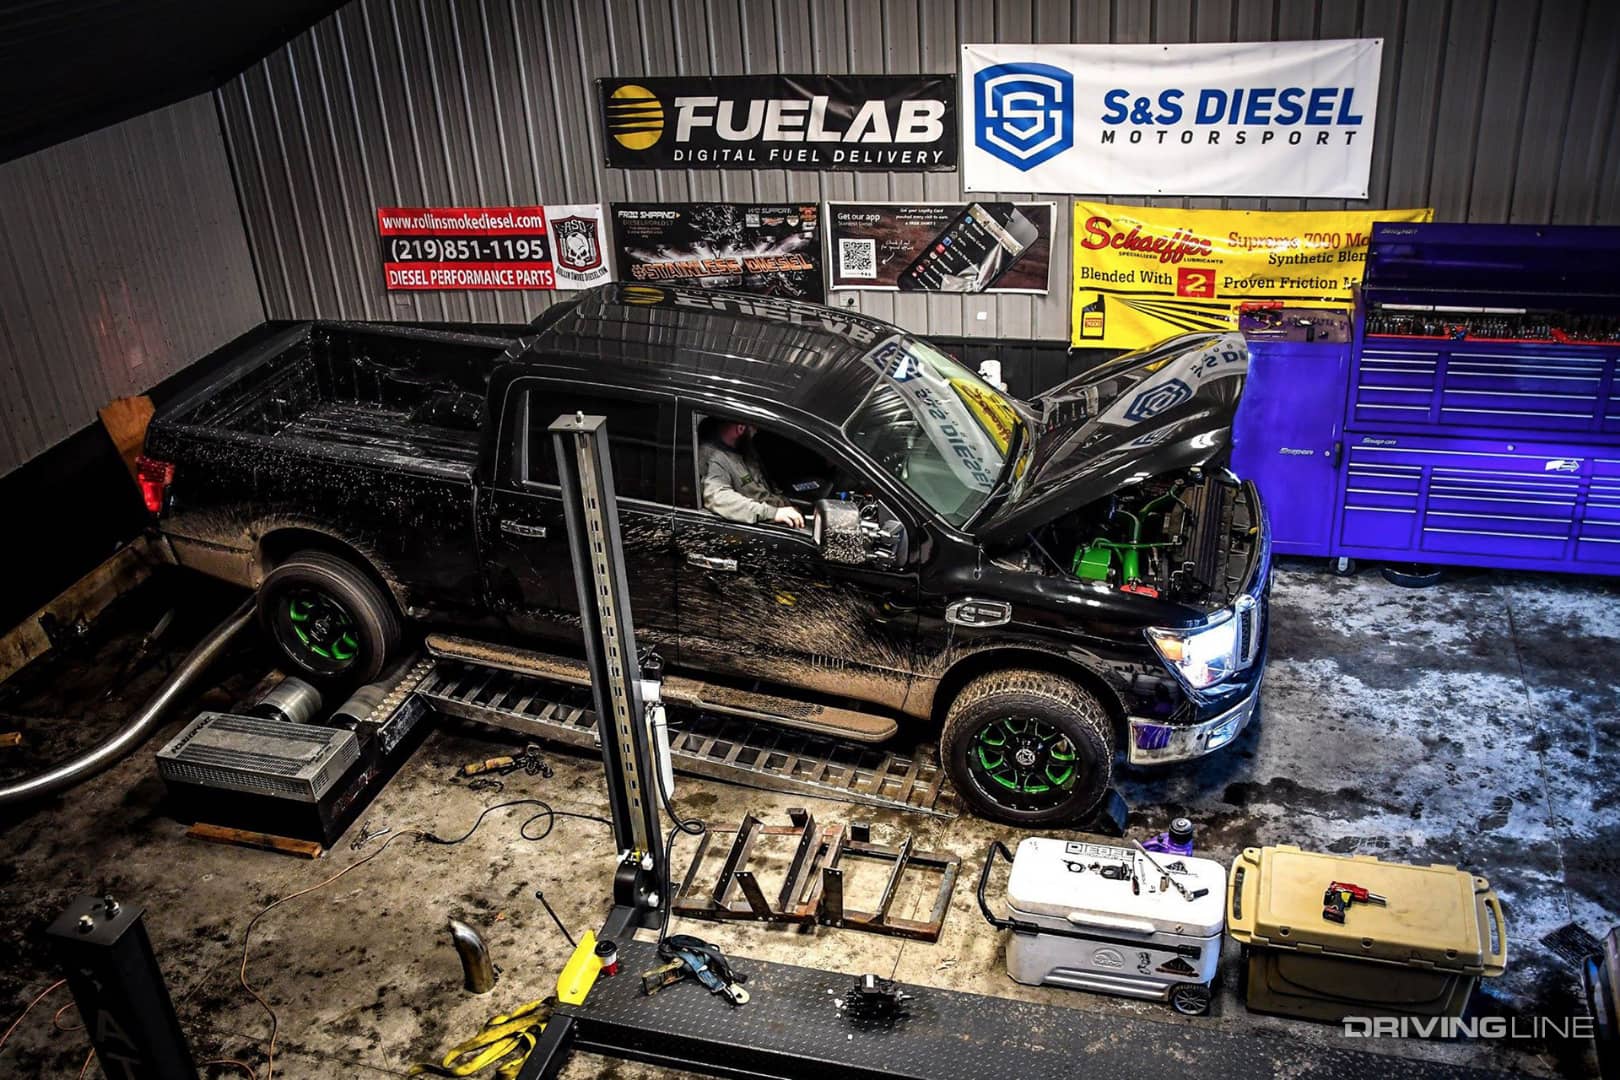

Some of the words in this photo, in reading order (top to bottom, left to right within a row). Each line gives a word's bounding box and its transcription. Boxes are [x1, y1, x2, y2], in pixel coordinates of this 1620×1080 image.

[1101, 88, 1185, 126] S&S
[1194, 86, 1364, 126] DIESEL
[674, 96, 946, 143] FUELAB
[1101, 130, 1359, 146] MOTORSPORT
[674, 149, 756, 161] DIGITAL
[769, 149, 821, 162] FUEL
[833, 150, 944, 164] DELIVERY
[382, 213, 542, 231] www.rollinsmokediesel.com
[837, 212, 851, 221] Get
[852, 213, 865, 221] our
[866, 213, 880, 223] app
[1080, 216, 1213, 264] Schaeffer
[1228, 232, 1300, 251] Supreme
[1304, 232, 1341, 249] 7000
[391, 239, 544, 262] (219)851-1195
[1268, 252, 1334, 267] Synthetic
[743, 252, 814, 274] DIESEL
[389, 270, 429, 285] DIESEL
[430, 269, 514, 286] PERFORMANCE
[516, 269, 553, 286] PARTS
[1081, 267, 1135, 283] Blended
[1140, 270, 1173, 285] With
[1185, 273, 1207, 293] 2
[1224, 276, 1275, 289] Proven
[1280, 276, 1338, 289] Friction
